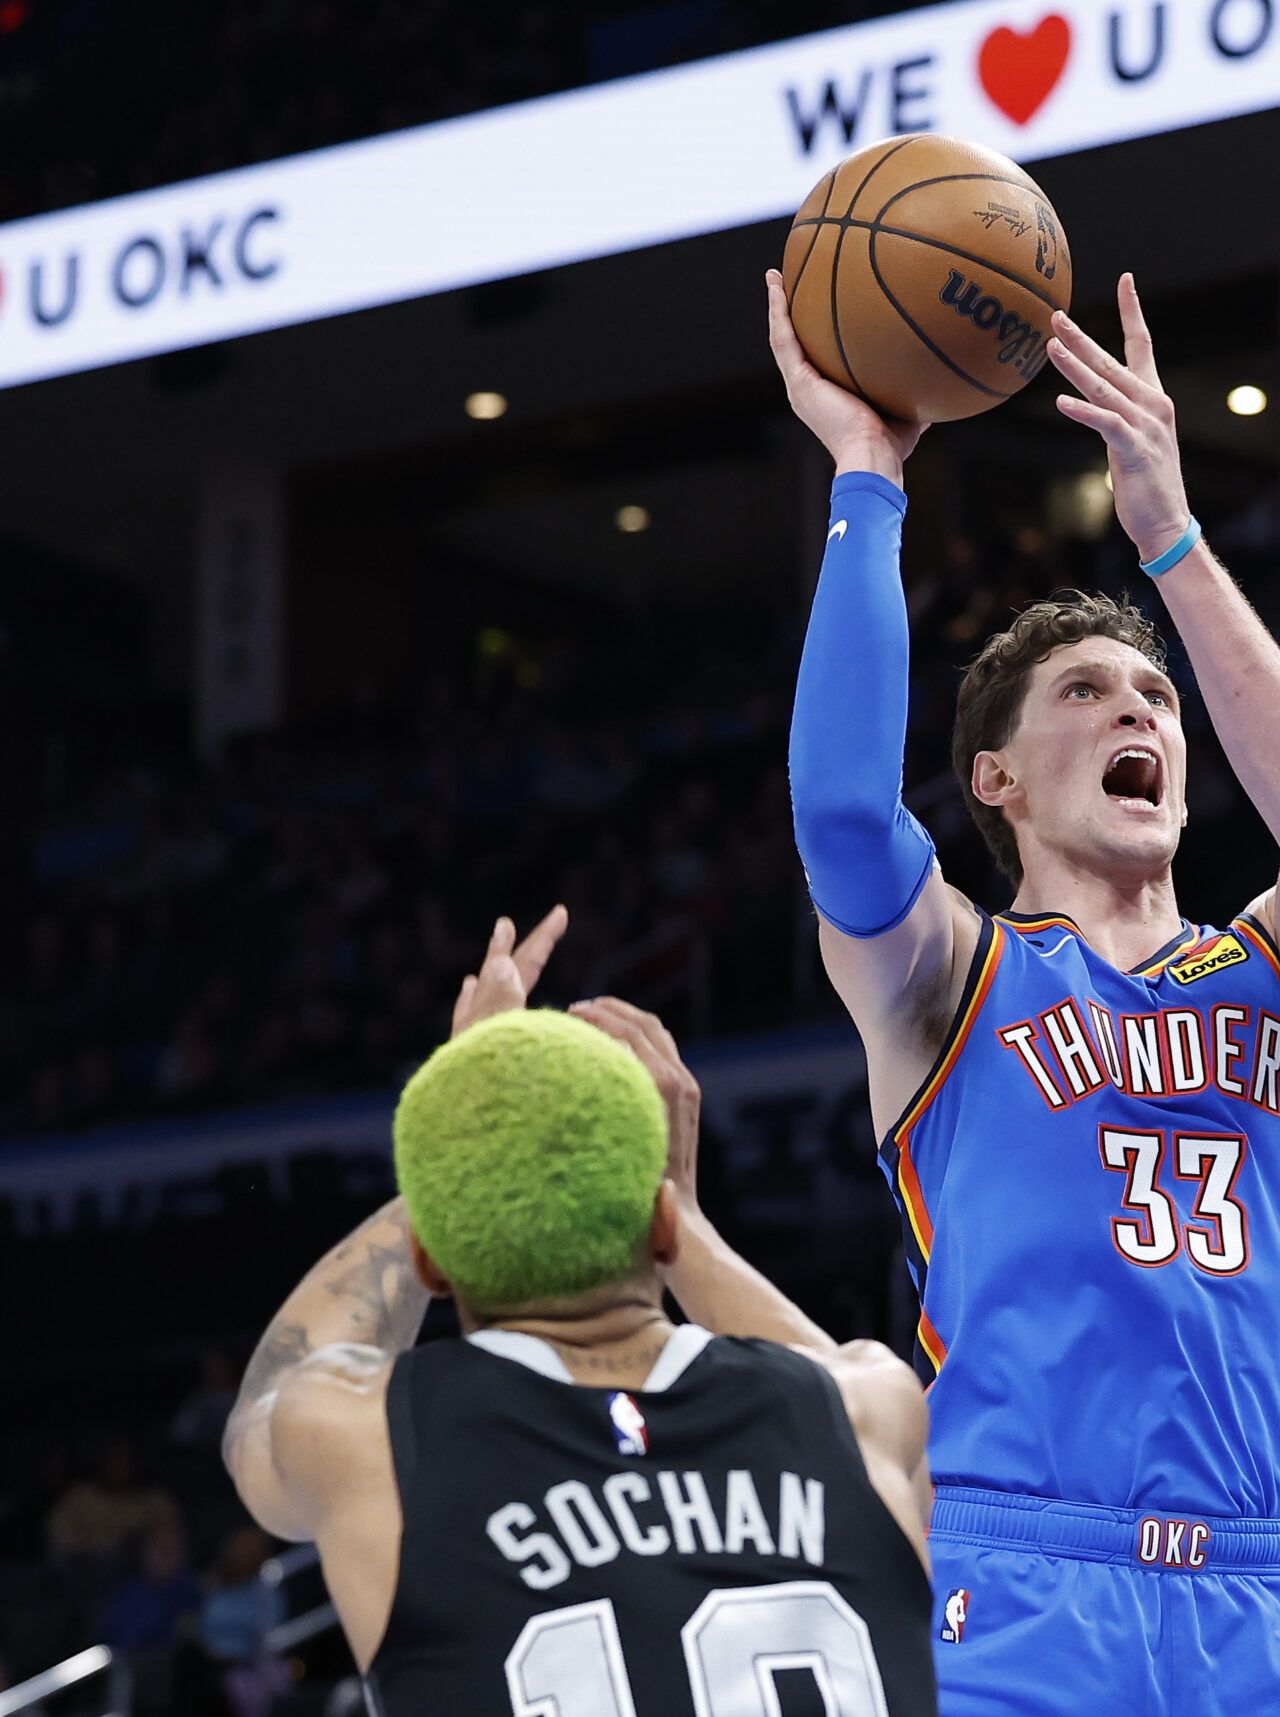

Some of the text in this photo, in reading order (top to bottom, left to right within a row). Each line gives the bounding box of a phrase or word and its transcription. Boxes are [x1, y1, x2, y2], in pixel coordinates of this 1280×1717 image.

[786, 55, 932, 154] WE
[1109, 3, 1165, 82] U
[29, 207, 282, 328] U OKC
[1177, 947, 1244, 981] Love's
[1098, 1122, 1251, 1278] 33
[486, 1469, 826, 1591] SOCHAN
[1137, 1516, 1211, 1569] OKC
